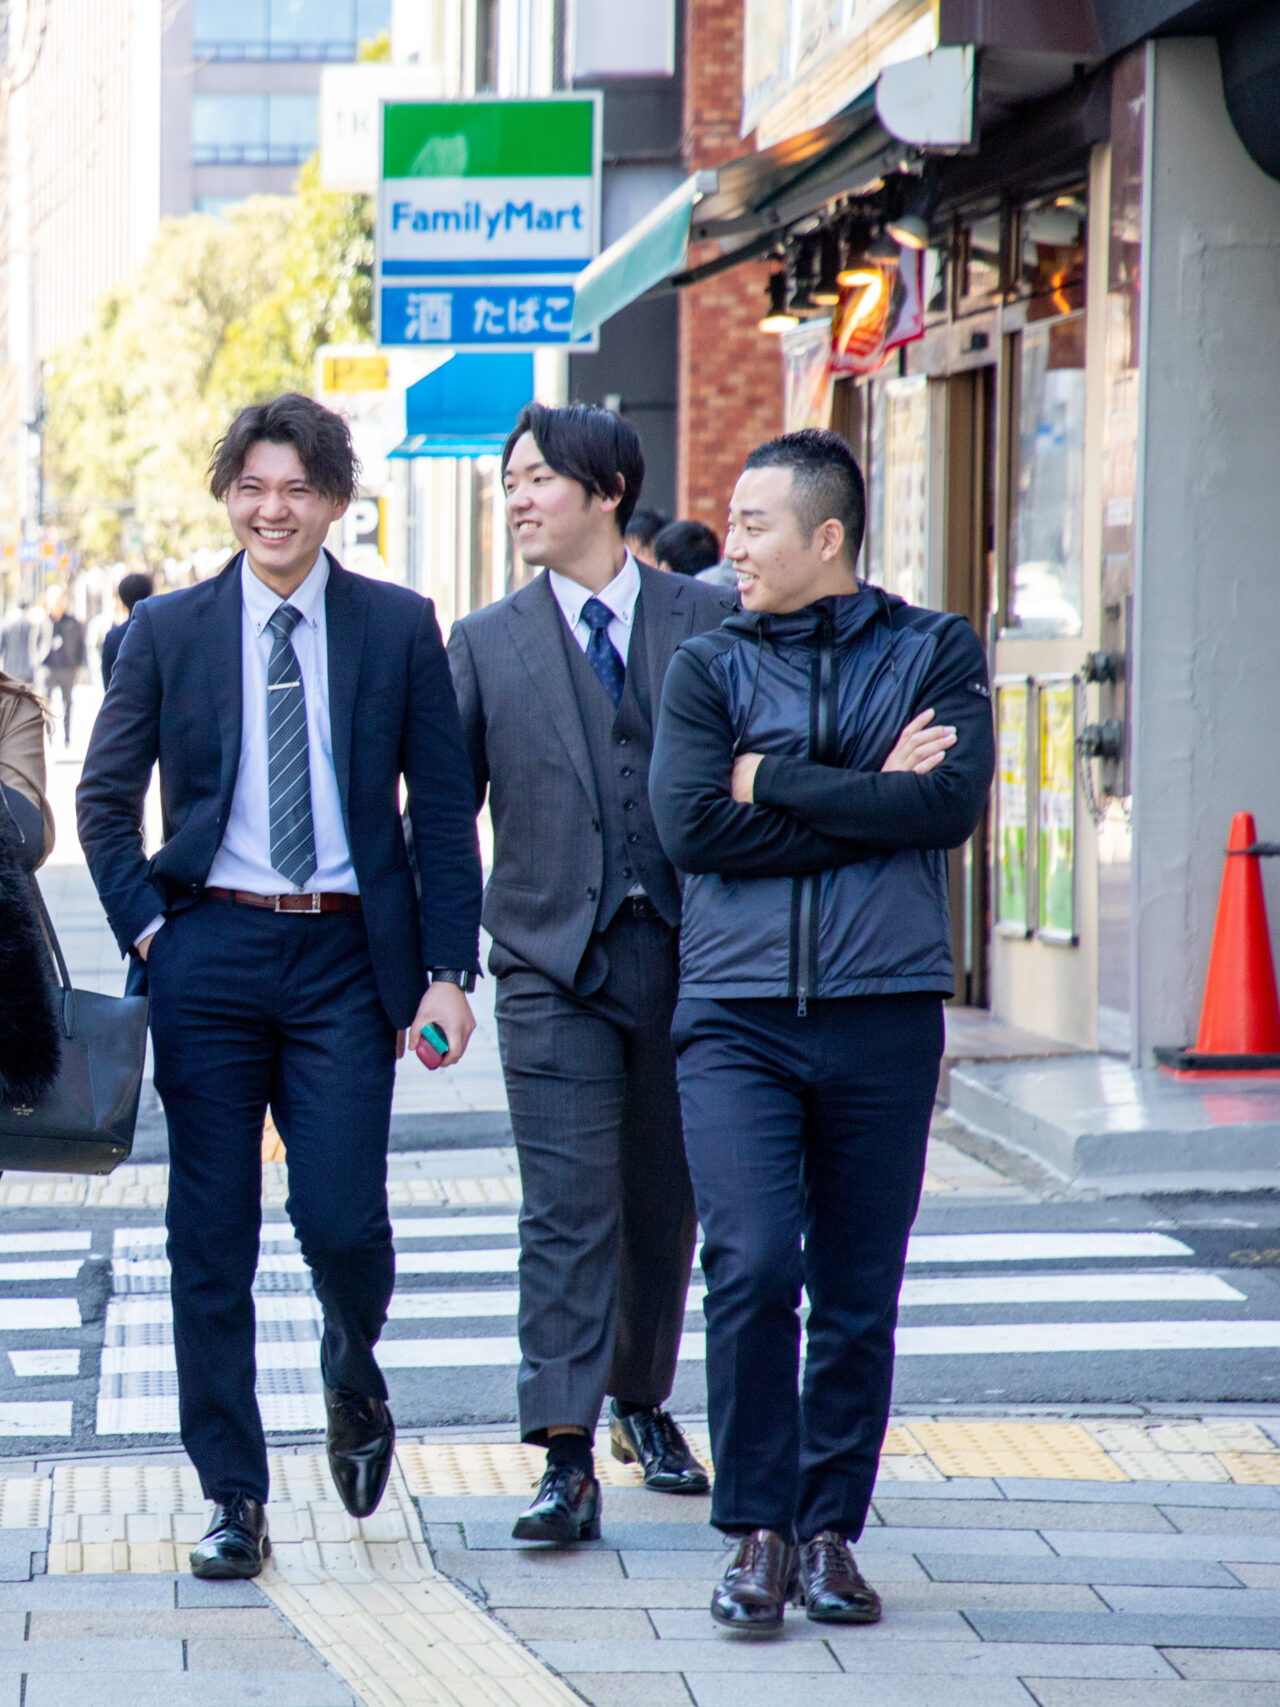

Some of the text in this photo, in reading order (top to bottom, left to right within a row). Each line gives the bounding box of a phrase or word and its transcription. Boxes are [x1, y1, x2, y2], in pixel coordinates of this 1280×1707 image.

[392, 201, 582, 240] FamilyMart
[405, 293, 573, 340] 酒 たばこ
[345, 500, 379, 545] P
